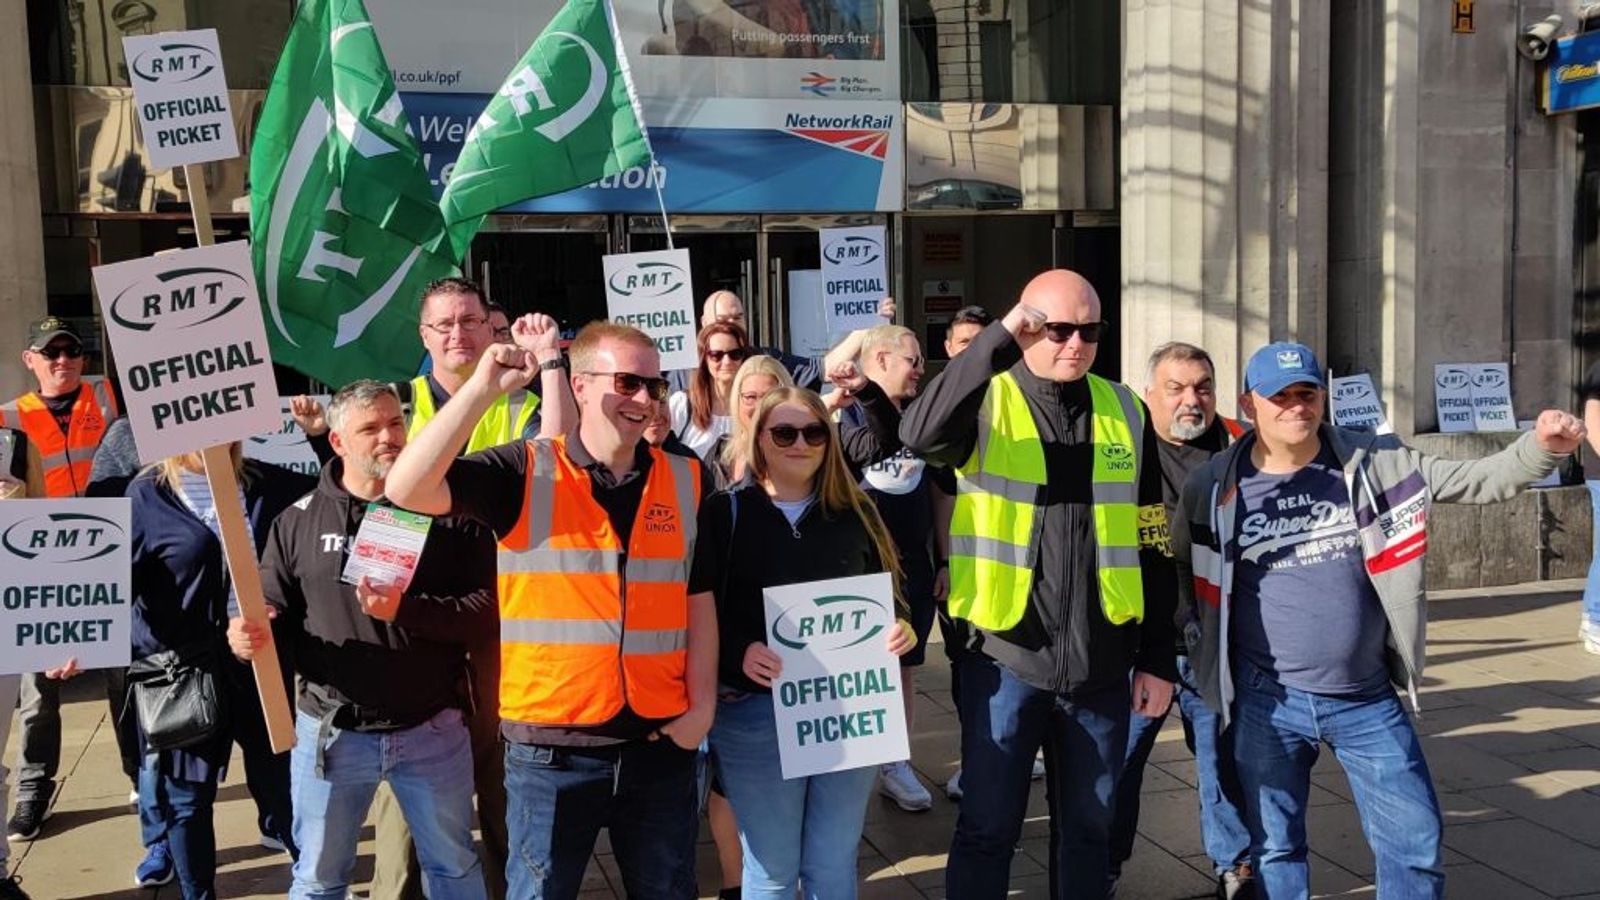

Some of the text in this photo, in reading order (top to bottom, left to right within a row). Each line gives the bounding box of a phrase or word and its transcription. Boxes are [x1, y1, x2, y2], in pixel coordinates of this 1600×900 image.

[732, 30, 870, 45] Putting passengers first
[152, 54, 201, 73] RMT
[393, 69, 462, 86] l.co.uk/ppf
[143, 95, 226, 122] OFFICIAL
[785, 113, 893, 129] NetworkRail
[157, 123, 222, 148] PICKET
[836, 244, 872, 258] RMT
[626, 272, 672, 289] RMT
[826, 278, 884, 295] OFFICIAL
[142, 282, 223, 318] RMT
[834, 300, 879, 317] PICKET
[653, 336, 684, 353] KET
[128, 341, 264, 392] OFFICIAL
[1337, 386, 1363, 396] RMT
[152, 383, 256, 430] PICKET
[1438, 398, 1473, 408] OFFICIAL
[1474, 397, 1509, 407] OFFICIAL
[1336, 404, 1379, 418] OFFICIAL
[1444, 412, 1470, 422] PICKET
[1480, 411, 1507, 420] PICKET
[1277, 493, 1316, 511] REAL
[29, 528, 104, 548] RMT
[3, 583, 125, 610] OFFICIAL
[799, 609, 867, 638] RMT
[16, 619, 113, 646] PICKET
[779, 667, 896, 708] OFFICIAL
[796, 708, 886, 747] PICKET
